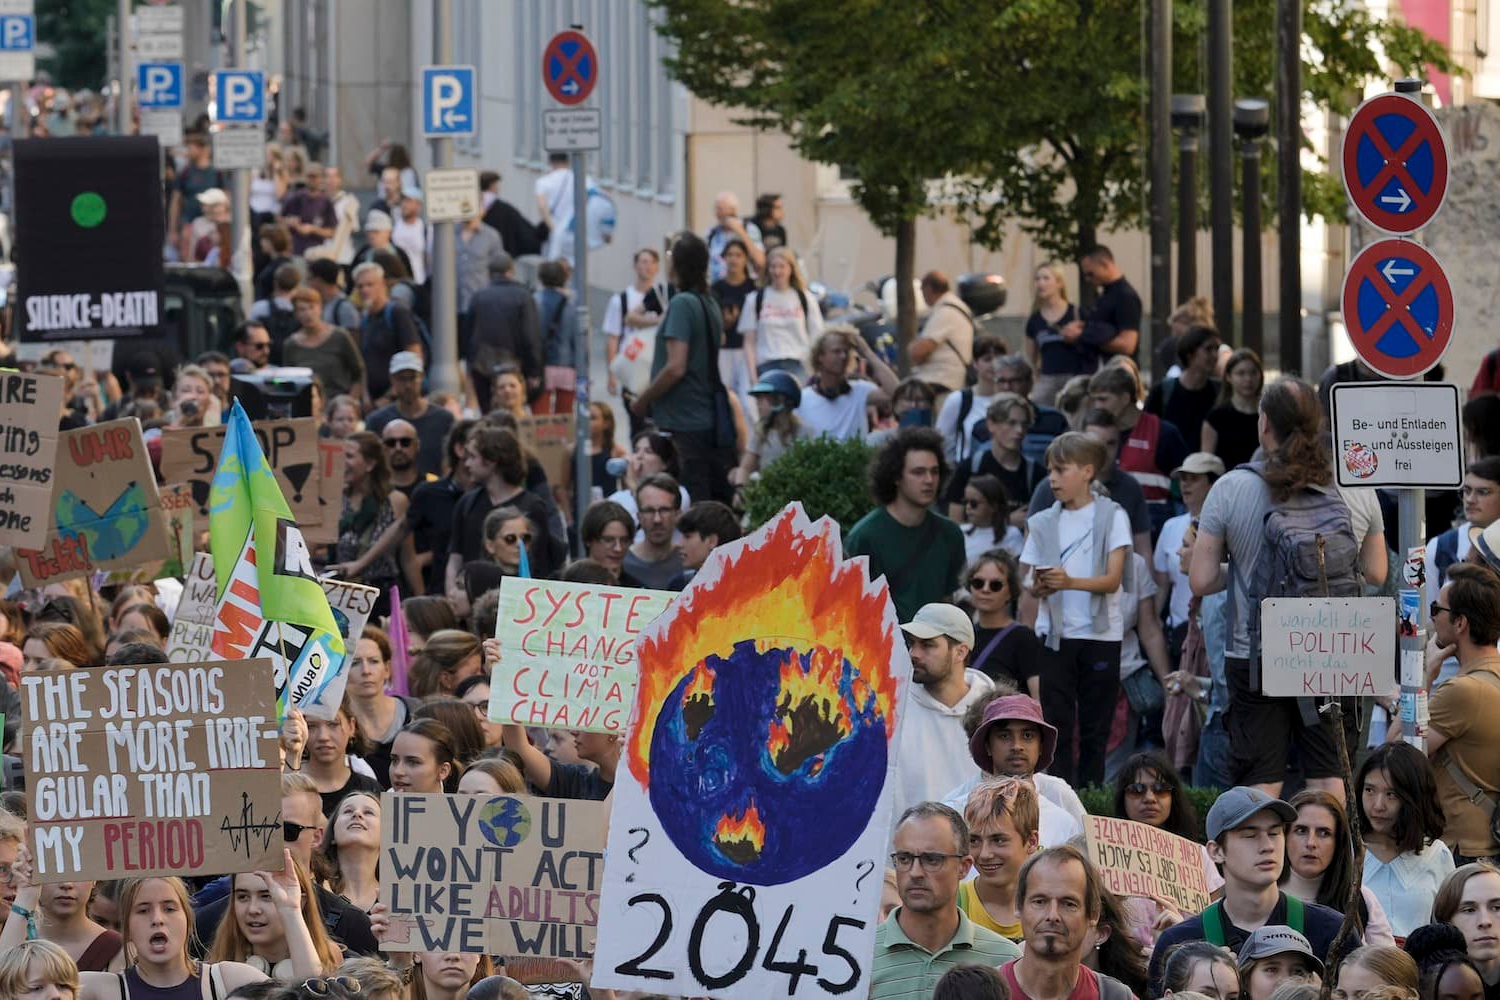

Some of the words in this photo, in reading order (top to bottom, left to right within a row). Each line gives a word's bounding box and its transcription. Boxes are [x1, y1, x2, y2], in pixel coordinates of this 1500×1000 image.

[150, 67, 172, 102] P
[225, 75, 254, 117] P
[432, 75, 462, 128] P
[1353, 419, 1373, 431] Be-
[1377, 419, 1398, 430] und
[1402, 419, 1447, 431] Entladen
[68, 427, 133, 466] UHR
[191, 427, 296, 474] SP
[1372, 440, 1393, 451] und
[1397, 440, 1454, 453] Aussteigen
[1395, 459, 1412, 470] frei
[513, 586, 674, 634] SYSTE
[1348, 609, 1373, 629] die
[1274, 653, 1315, 671] nicht
[1289, 632, 1377, 654] POLITIK
[513, 667, 638, 703] CLIMA
[573, 662, 615, 679] NOT
[1303, 671, 1376, 695] KLIMA
[21, 671, 92, 722] THE
[99, 667, 225, 720] SEASONS
[32, 721, 89, 774] ARE
[105, 718, 197, 774] MORE
[205, 715, 279, 770] IRRE-
[35, 773, 130, 822] GULAR
[138, 772, 212, 819] THAN
[392, 796, 427, 845] IF
[447, 796, 567, 849] YOU
[34, 825, 85, 875] MY
[103, 818, 206, 872] PERIOD
[1097, 843, 1132, 870] AUCH
[1136, 849, 1152, 873] ES
[388, 845, 515, 883] WONT
[532, 850, 604, 891] ACT
[391, 883, 474, 916] LIKE
[483, 885, 602, 926] ADULTS
[416, 915, 485, 953] WE
[510, 921, 596, 959] WILL
[616, 884, 867, 996] 2045
